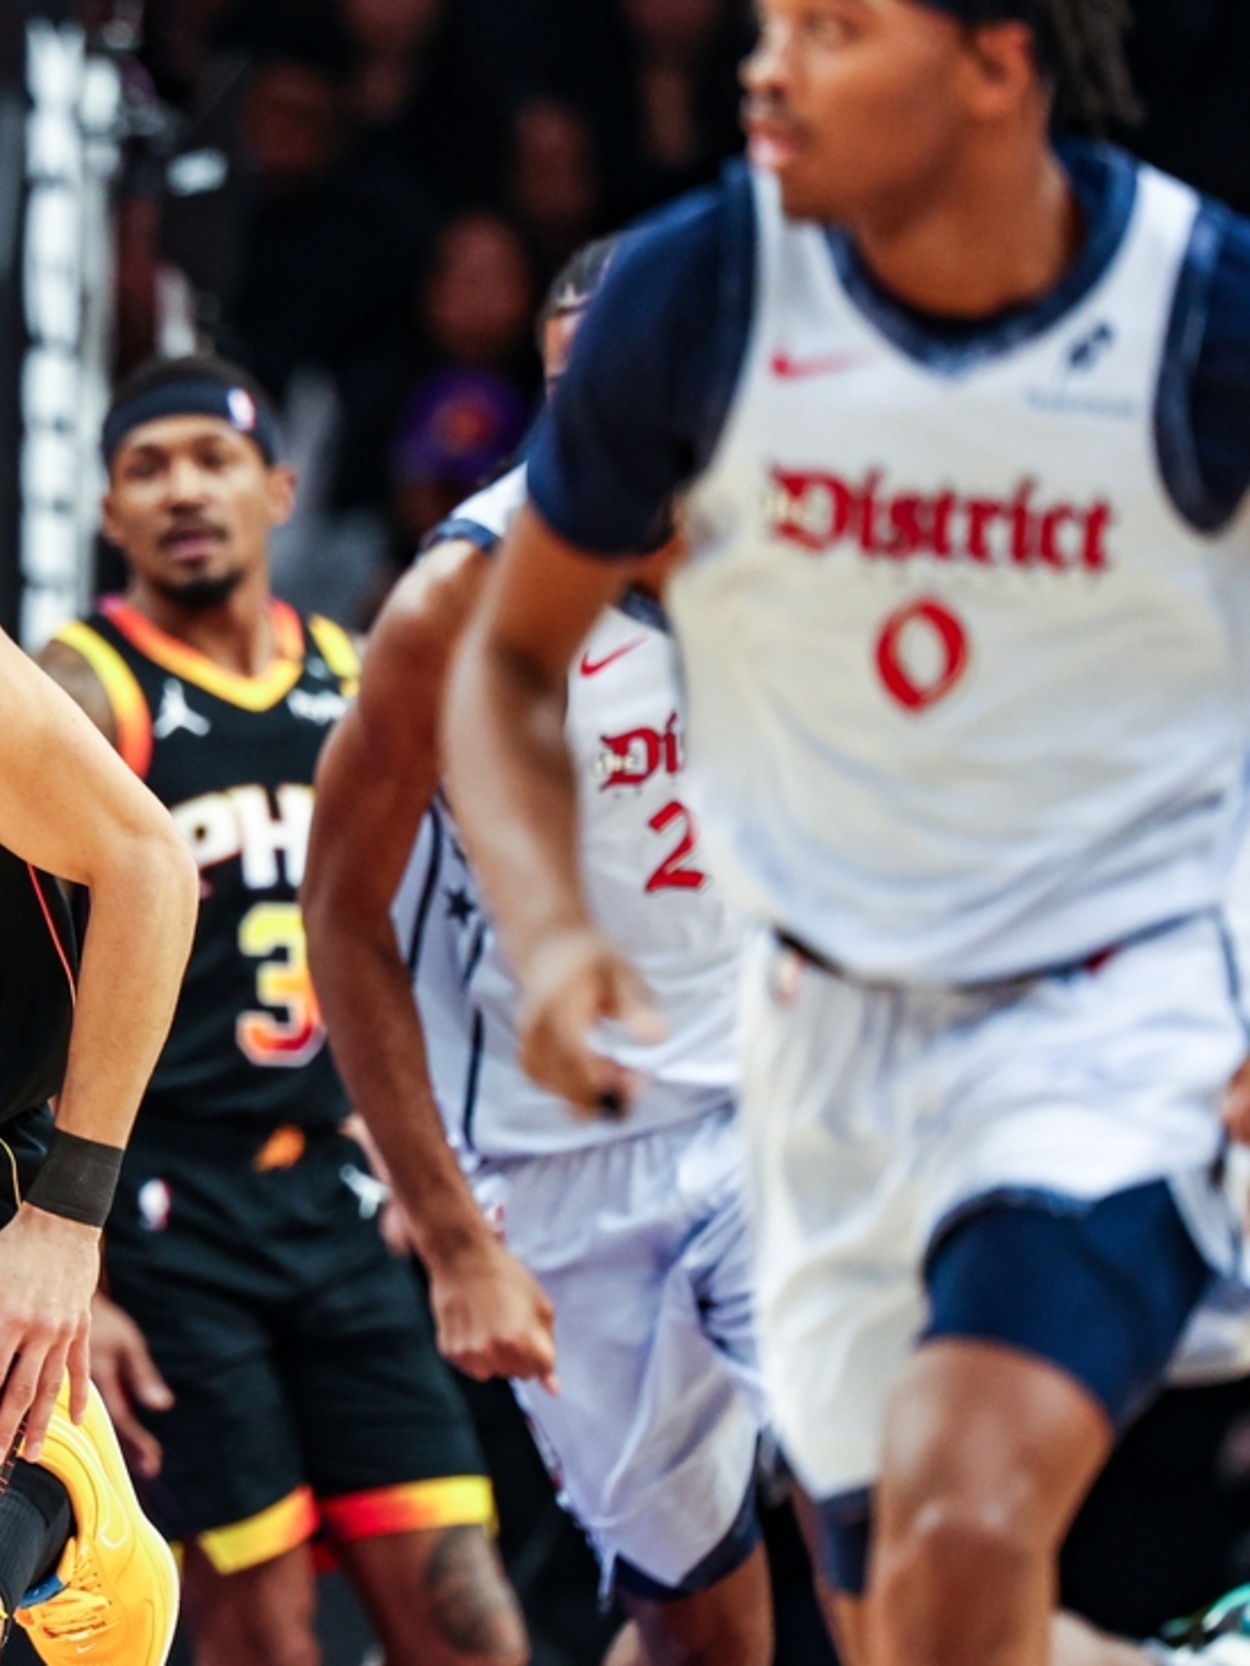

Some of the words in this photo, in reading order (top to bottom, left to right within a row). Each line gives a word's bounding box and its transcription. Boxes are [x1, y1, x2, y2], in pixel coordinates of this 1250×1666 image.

[766, 465, 1112, 574] District
[875, 596, 970, 714] 0
[644, 800, 707, 893] 2
[236, 902, 327, 1069] 3
